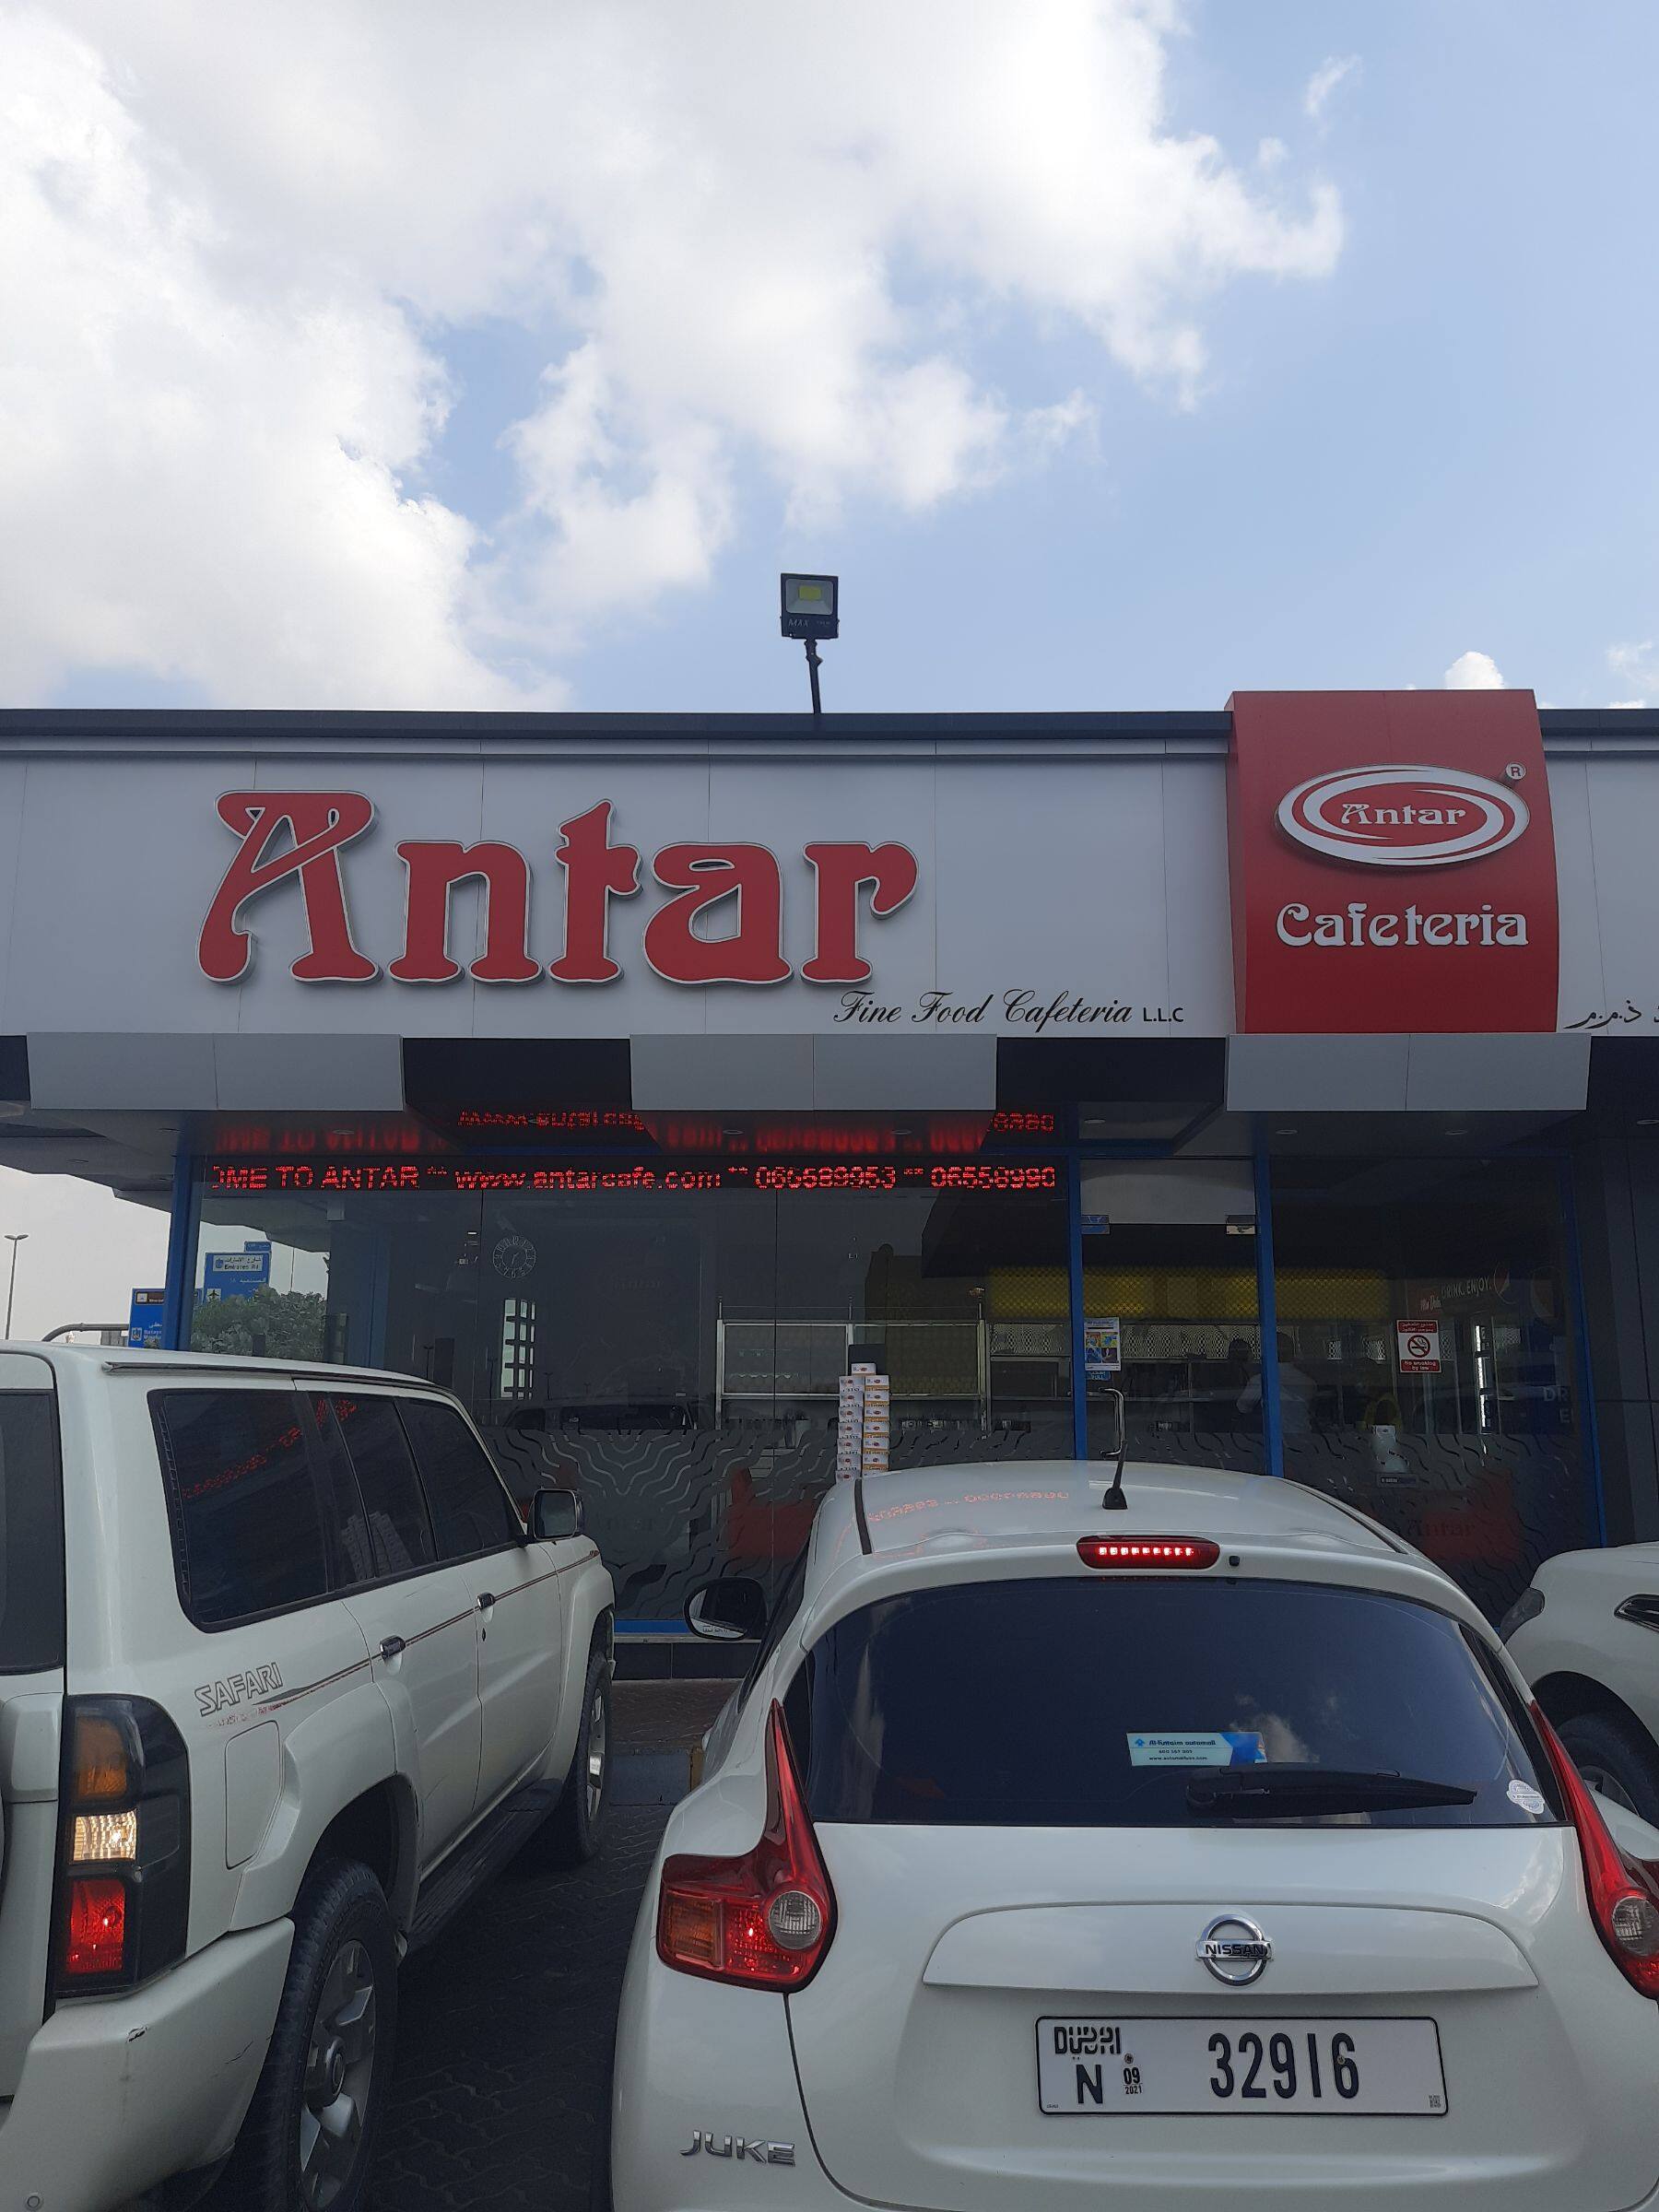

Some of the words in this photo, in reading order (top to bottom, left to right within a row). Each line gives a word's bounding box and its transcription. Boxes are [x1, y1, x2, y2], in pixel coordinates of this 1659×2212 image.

[1340, 803, 1465, 826] Antar
[196, 790, 920, 984] Antar
[1276, 902, 1530, 947] Cafeteria
[833, 990, 902, 1023] Fine
[911, 991, 994, 1023] Food
[1003, 988, 1133, 1033] Cafeteria
[1143, 1006, 1185, 1023] L.L.C
[275, 1165, 314, 1189] TO
[320, 1165, 420, 1190] ANTAR
[454, 1166, 722, 1190] www.antarcafe.com
[194, 1662, 284, 1717] SAFARI
[1205, 1944, 1264, 1955] NISSAN
[1053, 2026, 1122, 2054] DUBAI
[1077, 2064, 1103, 2104] N
[1207, 2032, 1359, 2099] 32916
[1123, 2066, 1141, 2085] 09
[1124, 2086, 1143, 2095] 2021
[679, 2130, 796, 2167] JUKE
